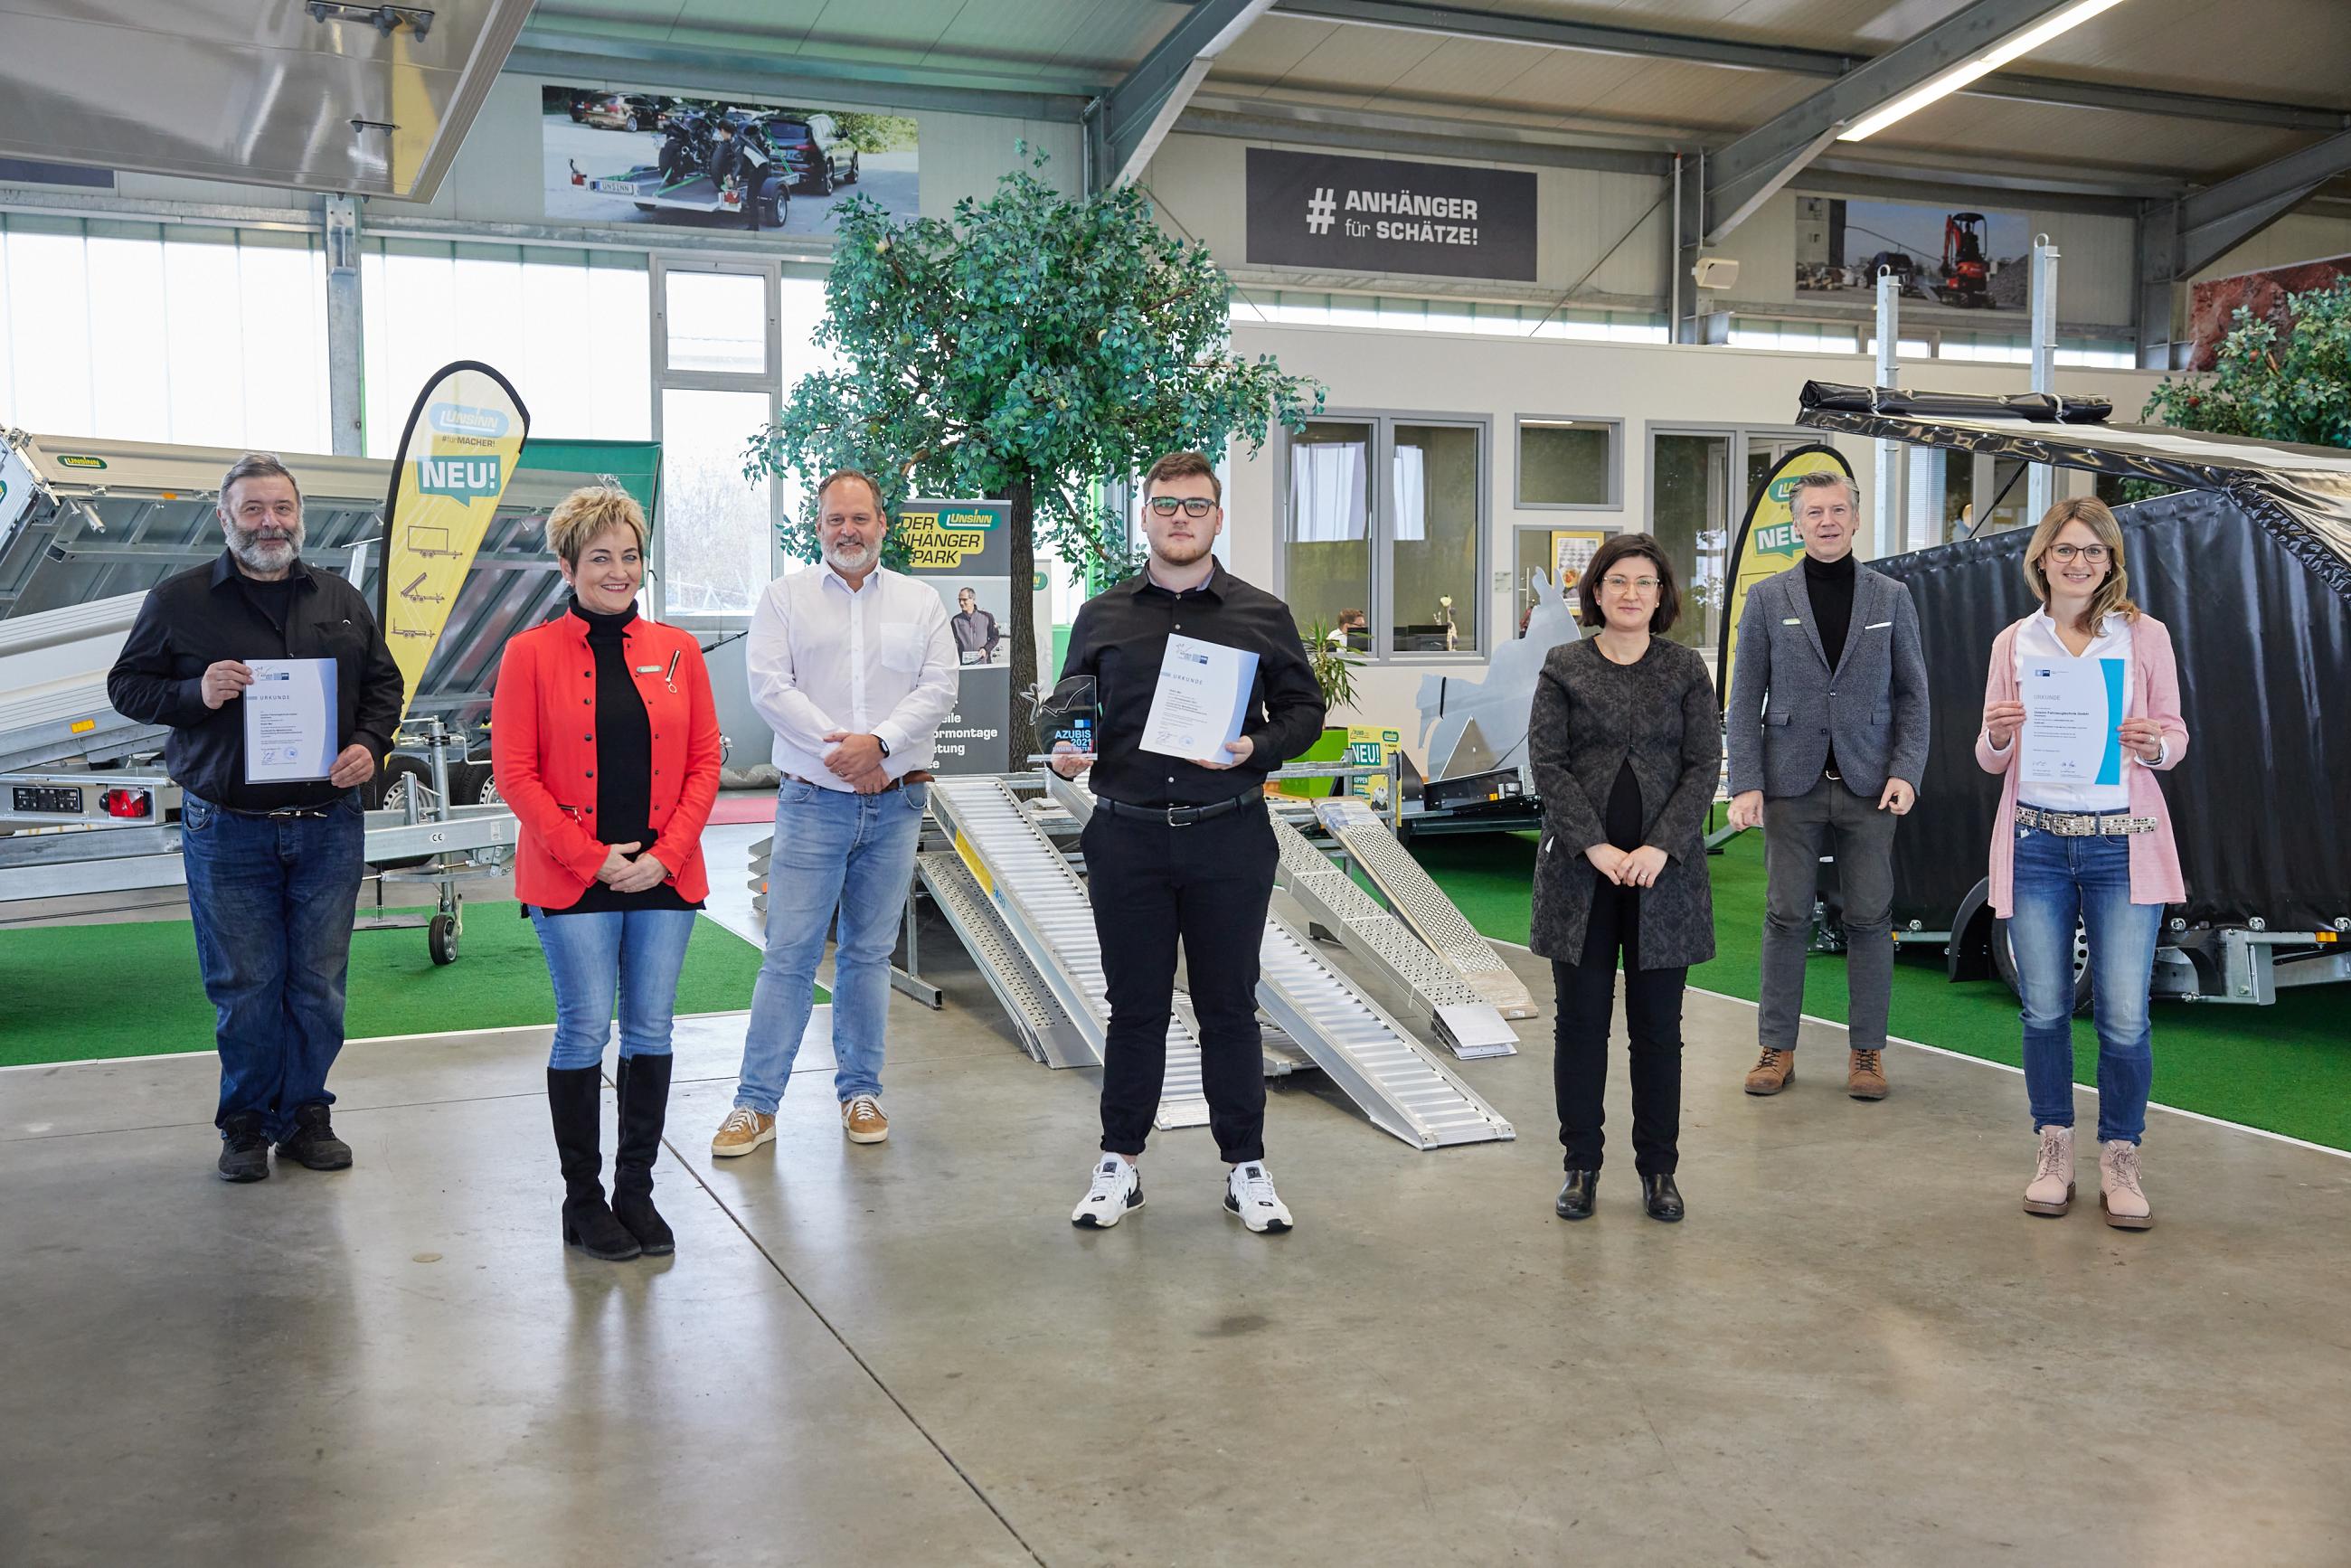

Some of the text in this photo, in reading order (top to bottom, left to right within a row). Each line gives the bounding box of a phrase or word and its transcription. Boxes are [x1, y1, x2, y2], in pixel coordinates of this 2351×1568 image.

[1345, 189, 1478, 221] ANHÄNGER
[1345, 218, 1478, 246] für SCHÄTZE!
[446, 407, 498, 429] UNSINN
[422, 461, 497, 489] NEU!
[902, 515, 935, 531] DER
[950, 508, 993, 524] UNSINN
[899, 530, 980, 548] NHÄNGER
[1173, 673, 1203, 685] URKUNDE
[933, 728, 998, 741] ormontage
[1054, 729, 1091, 740] AZUBIS
[1071, 738, 1091, 747] 2021
[1351, 743, 1380, 763] NEU!
